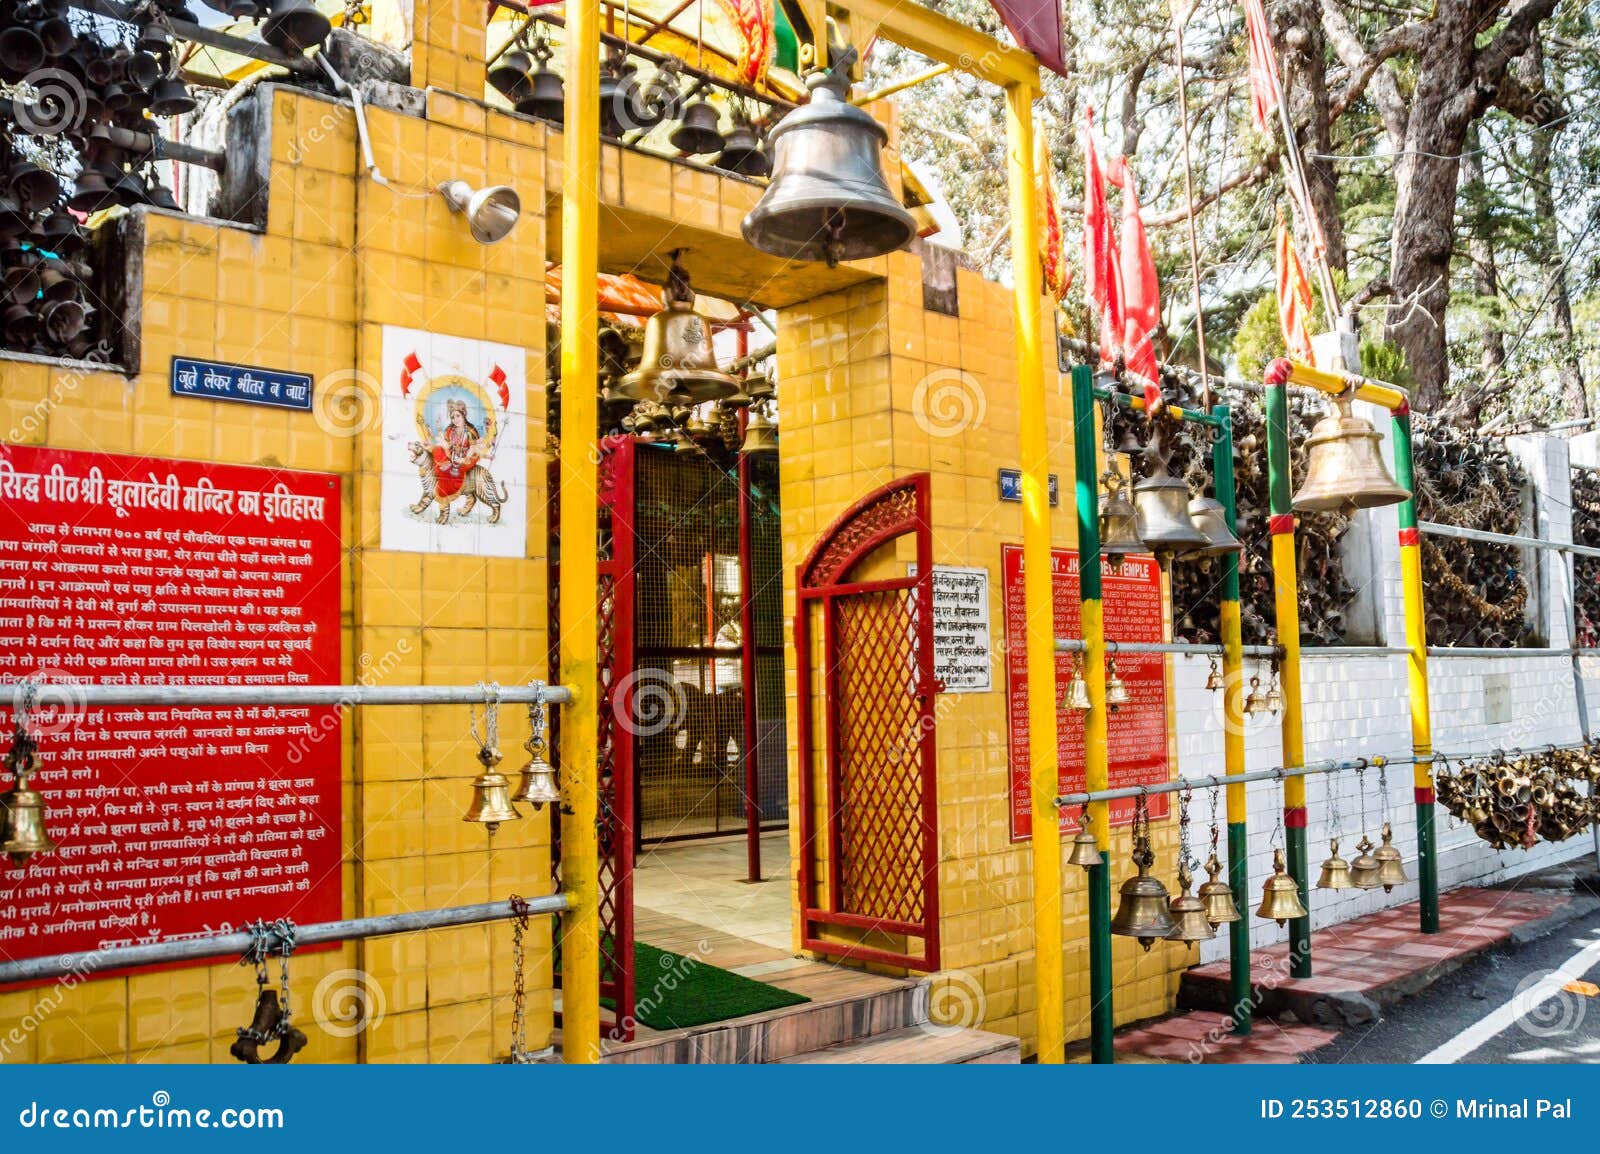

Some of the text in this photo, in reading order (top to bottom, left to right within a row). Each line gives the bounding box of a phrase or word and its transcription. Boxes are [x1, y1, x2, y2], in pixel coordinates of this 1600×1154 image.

[179, 366, 198, 389] जूते
[204, 368, 232, 391] लेकर
[237, 372, 264, 395] भीतर
[270, 382, 280, 398] न
[44, 464, 81, 502] पीठ
[79, 466, 104, 504] श्री
[107, 472, 181, 518] झूलादेवी
[183, 477, 234, 514] मन्दिर
[238, 491, 261, 516] का
[263, 483, 324, 522] इतिहास
[28, 523, 56, 534] आज
[59, 522, 69, 535] से
[72, 526, 112, 537] लगभग
[227, 536, 246, 546] एक
[270, 536, 296, 548] जंगल
[22, 539, 312, 565] जंगली जानवरों से भरा वाली
[32, 561, 48, 571] पर
[51, 562, 99, 573] आक्रमण
[102, 562, 128, 575] करते
[222, 568, 237, 579] को
[239, 571, 269, 580] अपना
[272, 572, 301, 582] आहार
[38, 581, 55, 592] इन
[181, 583, 191, 595] से
[262, 586, 284, 598] सभी
[63, 598, 72, 610] ने
[100, 599, 114, 611] माँ
[141, 600, 157, 612] की
[240, 603, 254, 614] की
[280, 607, 301, 616] कहा
[38, 615, 54, 628] कि
[58, 616, 72, 628] माँ
[75, 616, 84, 628] ने
[235, 620, 245, 632] के
[248, 624, 266, 633] एक
[303, 621, 317, 632] को
[97, 635, 120, 648] और
[123, 639, 146, 649] कहा
[149, 636, 164, 648] कि
[187, 640, 204, 650] इस
[267, 640, 280, 649] पर
[20, 653, 34, 666] तो
[64, 653, 84, 666] मेरी
[88, 657, 107, 668] एक
[210, 658, 228, 667] उस
[234, 707, 244, 719] से
[246, 707, 259, 718] माँ
[99, 728, 110, 740] के
[236, 728, 251, 736] का
[206, 743, 217, 755] के
[66, 789, 82, 798] का
[196, 781, 209, 793] माँ
[130, 802, 143, 814] माँ
[299, 795, 319, 805] कहा
[209, 816, 223, 828] भी
[256, 812, 270, 824] की
[224, 833, 236, 844] माँ
[239, 831, 253, 843] की
[290, 827, 304, 839] को
[113, 859, 123, 871] से
[163, 858, 177, 867] का
[291, 845, 302, 857] हो
[54, 882, 65, 895] से
[205, 870, 219, 882] कि
[244, 866, 258, 878] की
[296, 878, 310, 890] की
